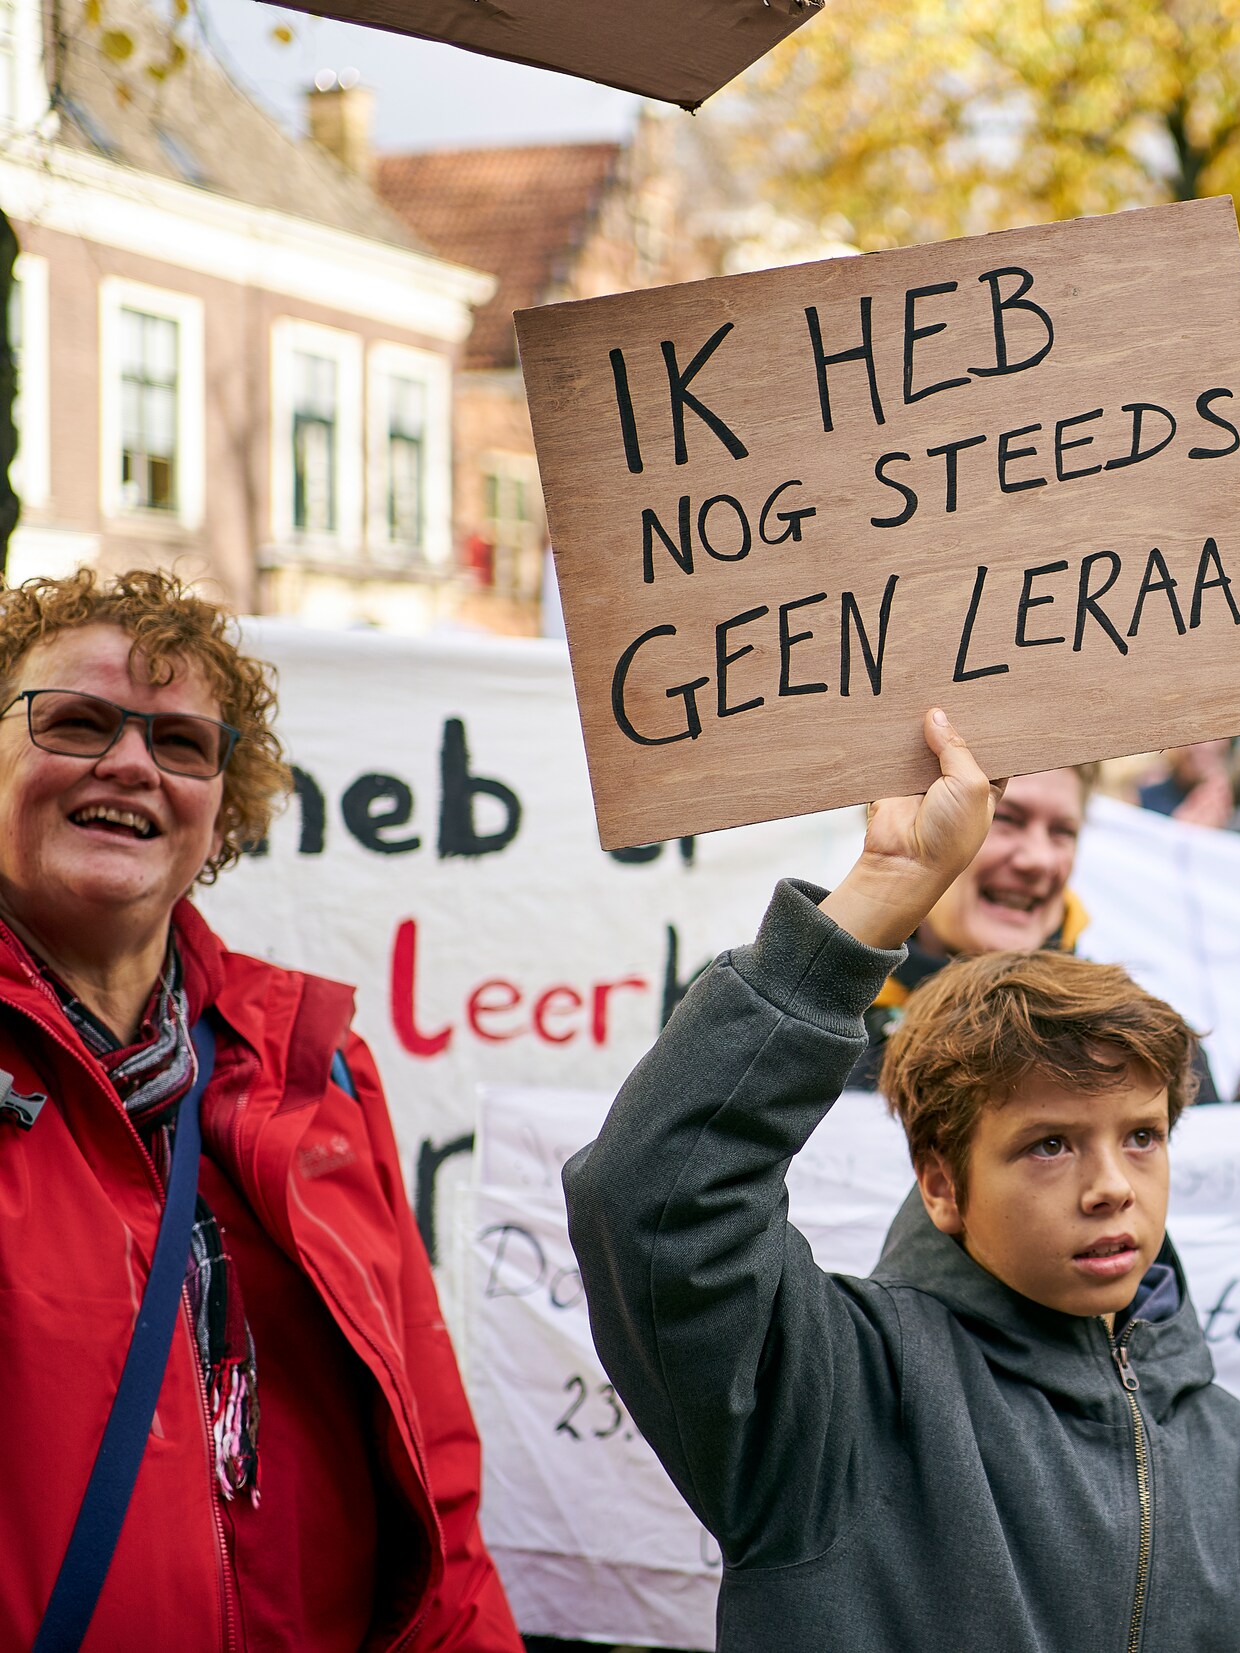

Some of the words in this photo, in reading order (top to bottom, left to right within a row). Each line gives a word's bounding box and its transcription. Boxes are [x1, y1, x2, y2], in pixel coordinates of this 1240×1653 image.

[608, 322, 750, 474] IK
[803, 266, 1054, 433] HEB
[641, 479, 817, 584] NOG
[870, 387, 1240, 529] STEEDS
[611, 574, 900, 746] GEEN
